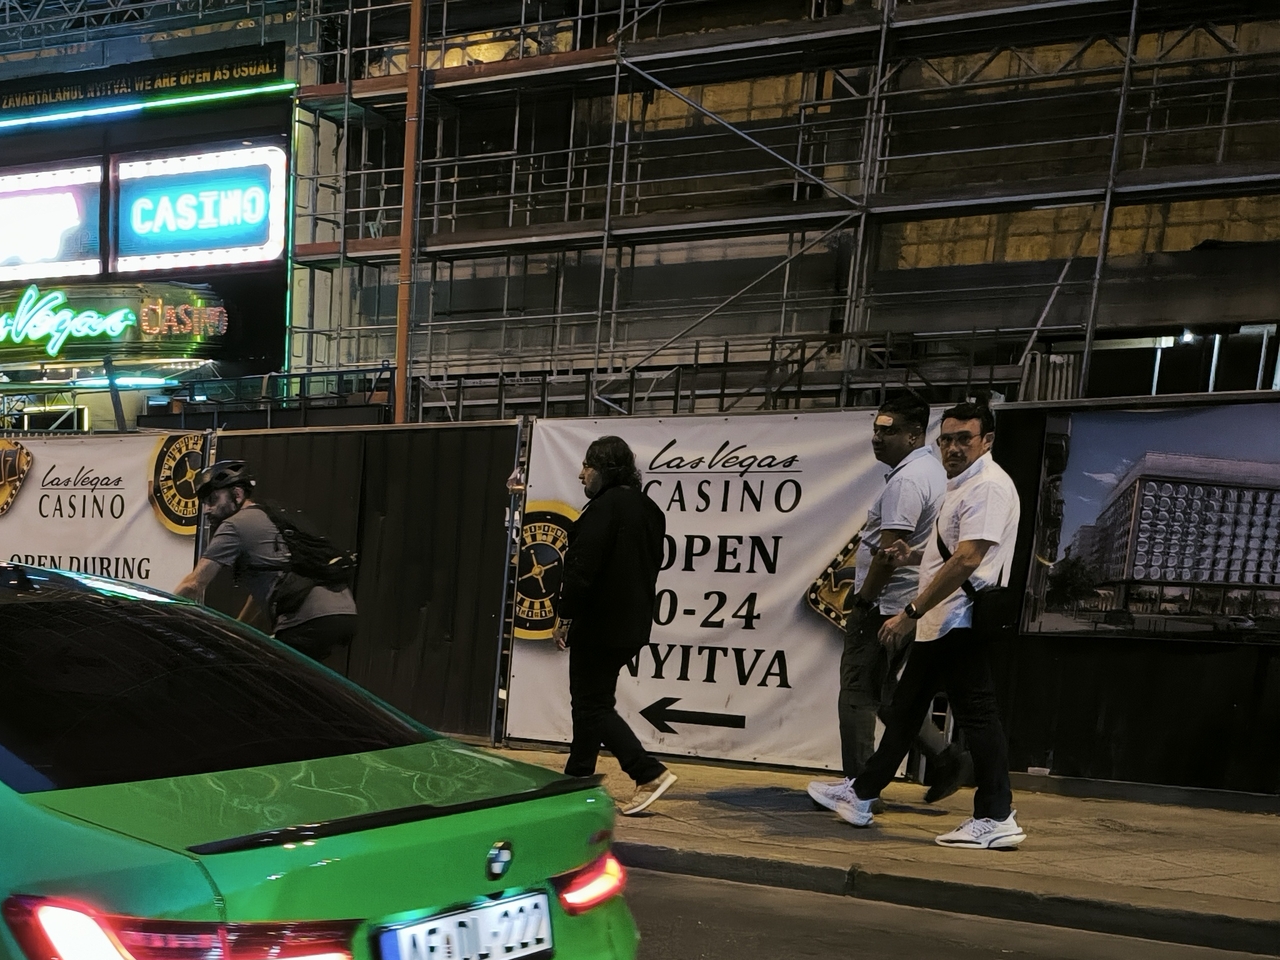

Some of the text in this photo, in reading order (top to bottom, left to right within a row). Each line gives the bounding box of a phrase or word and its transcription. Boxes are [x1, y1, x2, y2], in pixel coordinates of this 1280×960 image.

[135, 75, 152, 91] WE
[154, 72, 177, 89] ARE
[179, 68, 211, 85] OPEN
[213, 64, 230, 80] AS
[131, 186, 267, 235] CASINO
[140, 301, 229, 336] CASINO
[38, 493, 125, 519] CASINO
[68, 556, 151, 580] DURING
[653, 589, 761, 630] 0-24
